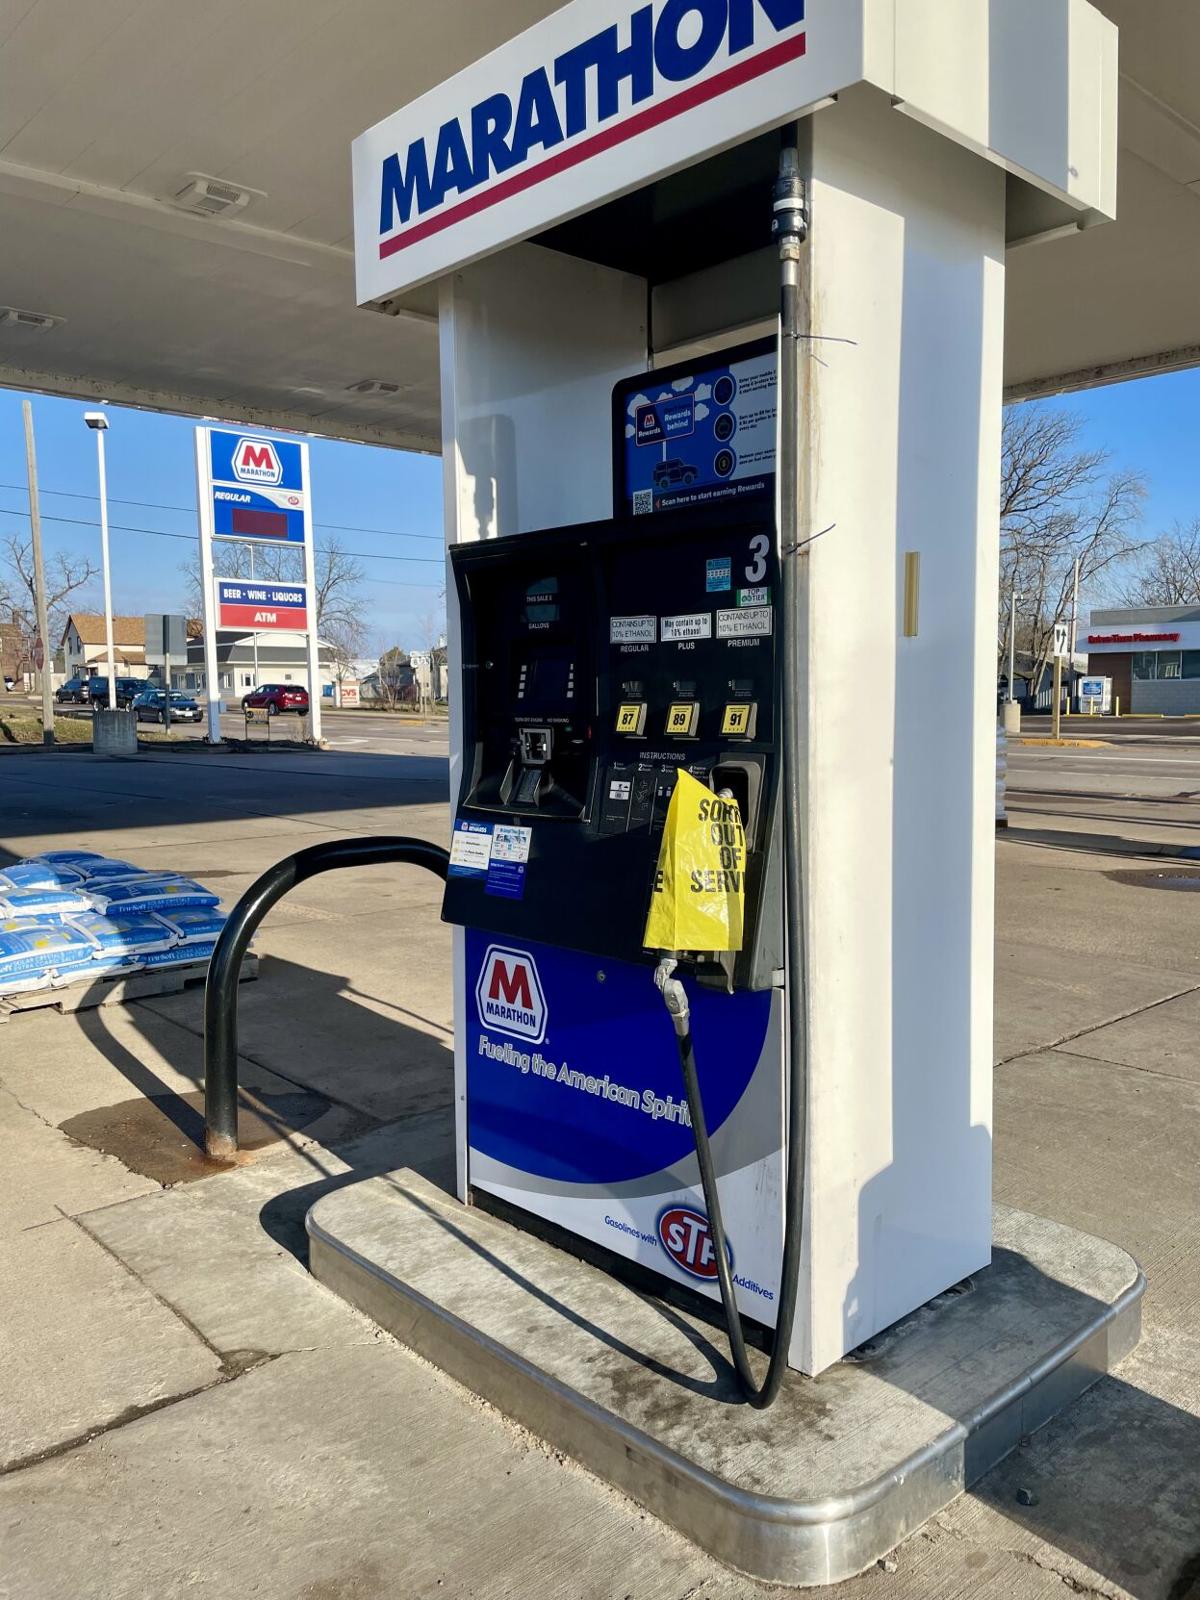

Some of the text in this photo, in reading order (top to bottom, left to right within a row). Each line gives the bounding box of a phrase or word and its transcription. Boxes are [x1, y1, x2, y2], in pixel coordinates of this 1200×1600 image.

[664, 409, 691, 422] Rewards
[667, 419, 689, 431] behind
[638, 427, 661, 438] Rewards
[242, 445, 274, 470] M
[240, 467, 276, 478] MARATHON
[698, 491, 712, 500] start
[713, 487, 737, 497] earning
[738, 481, 765, 493] Rewards
[214, 491, 251, 503] REGULAR
[745, 534, 770, 583] 3
[223, 588, 303, 603] BEER WINE LIQUORS
[254, 611, 277, 623] ATM
[719, 610, 769, 621] CONTAINS UP TO
[528, 622, 550, 630] GALLONS
[612, 620, 638, 628] CONTAINS
[665, 617, 708, 628] May contain up to
[719, 621, 767, 633] 10% ETHANOL
[625, 629, 653, 638] ETHANOL
[683, 628, 701, 636] ethanol
[620, 644, 649, 653] REGULAR
[677, 641, 695, 650] PLUS
[727, 638, 760, 648] PREMIUM
[341, 688, 357, 697] CVS
[622, 713, 634, 725] 87
[673, 713, 686, 726] 89
[730, 712, 742, 726] 91
[639, 751, 686, 760] INSTRUCTIONS
[638, 763, 643, 771] 2
[661, 764, 666, 772] 3
[688, 765, 694, 773] 4
[711, 823, 744, 847] OUT
[720, 846, 741, 870] OF
[488, 959, 534, 1010] M
[486, 1001, 537, 1028] MARATHON
[478, 1034, 693, 1128] Fueling the American Spirit
[604, 1215, 658, 1247] Gasolines with
[732, 1274, 774, 1300] Additives
